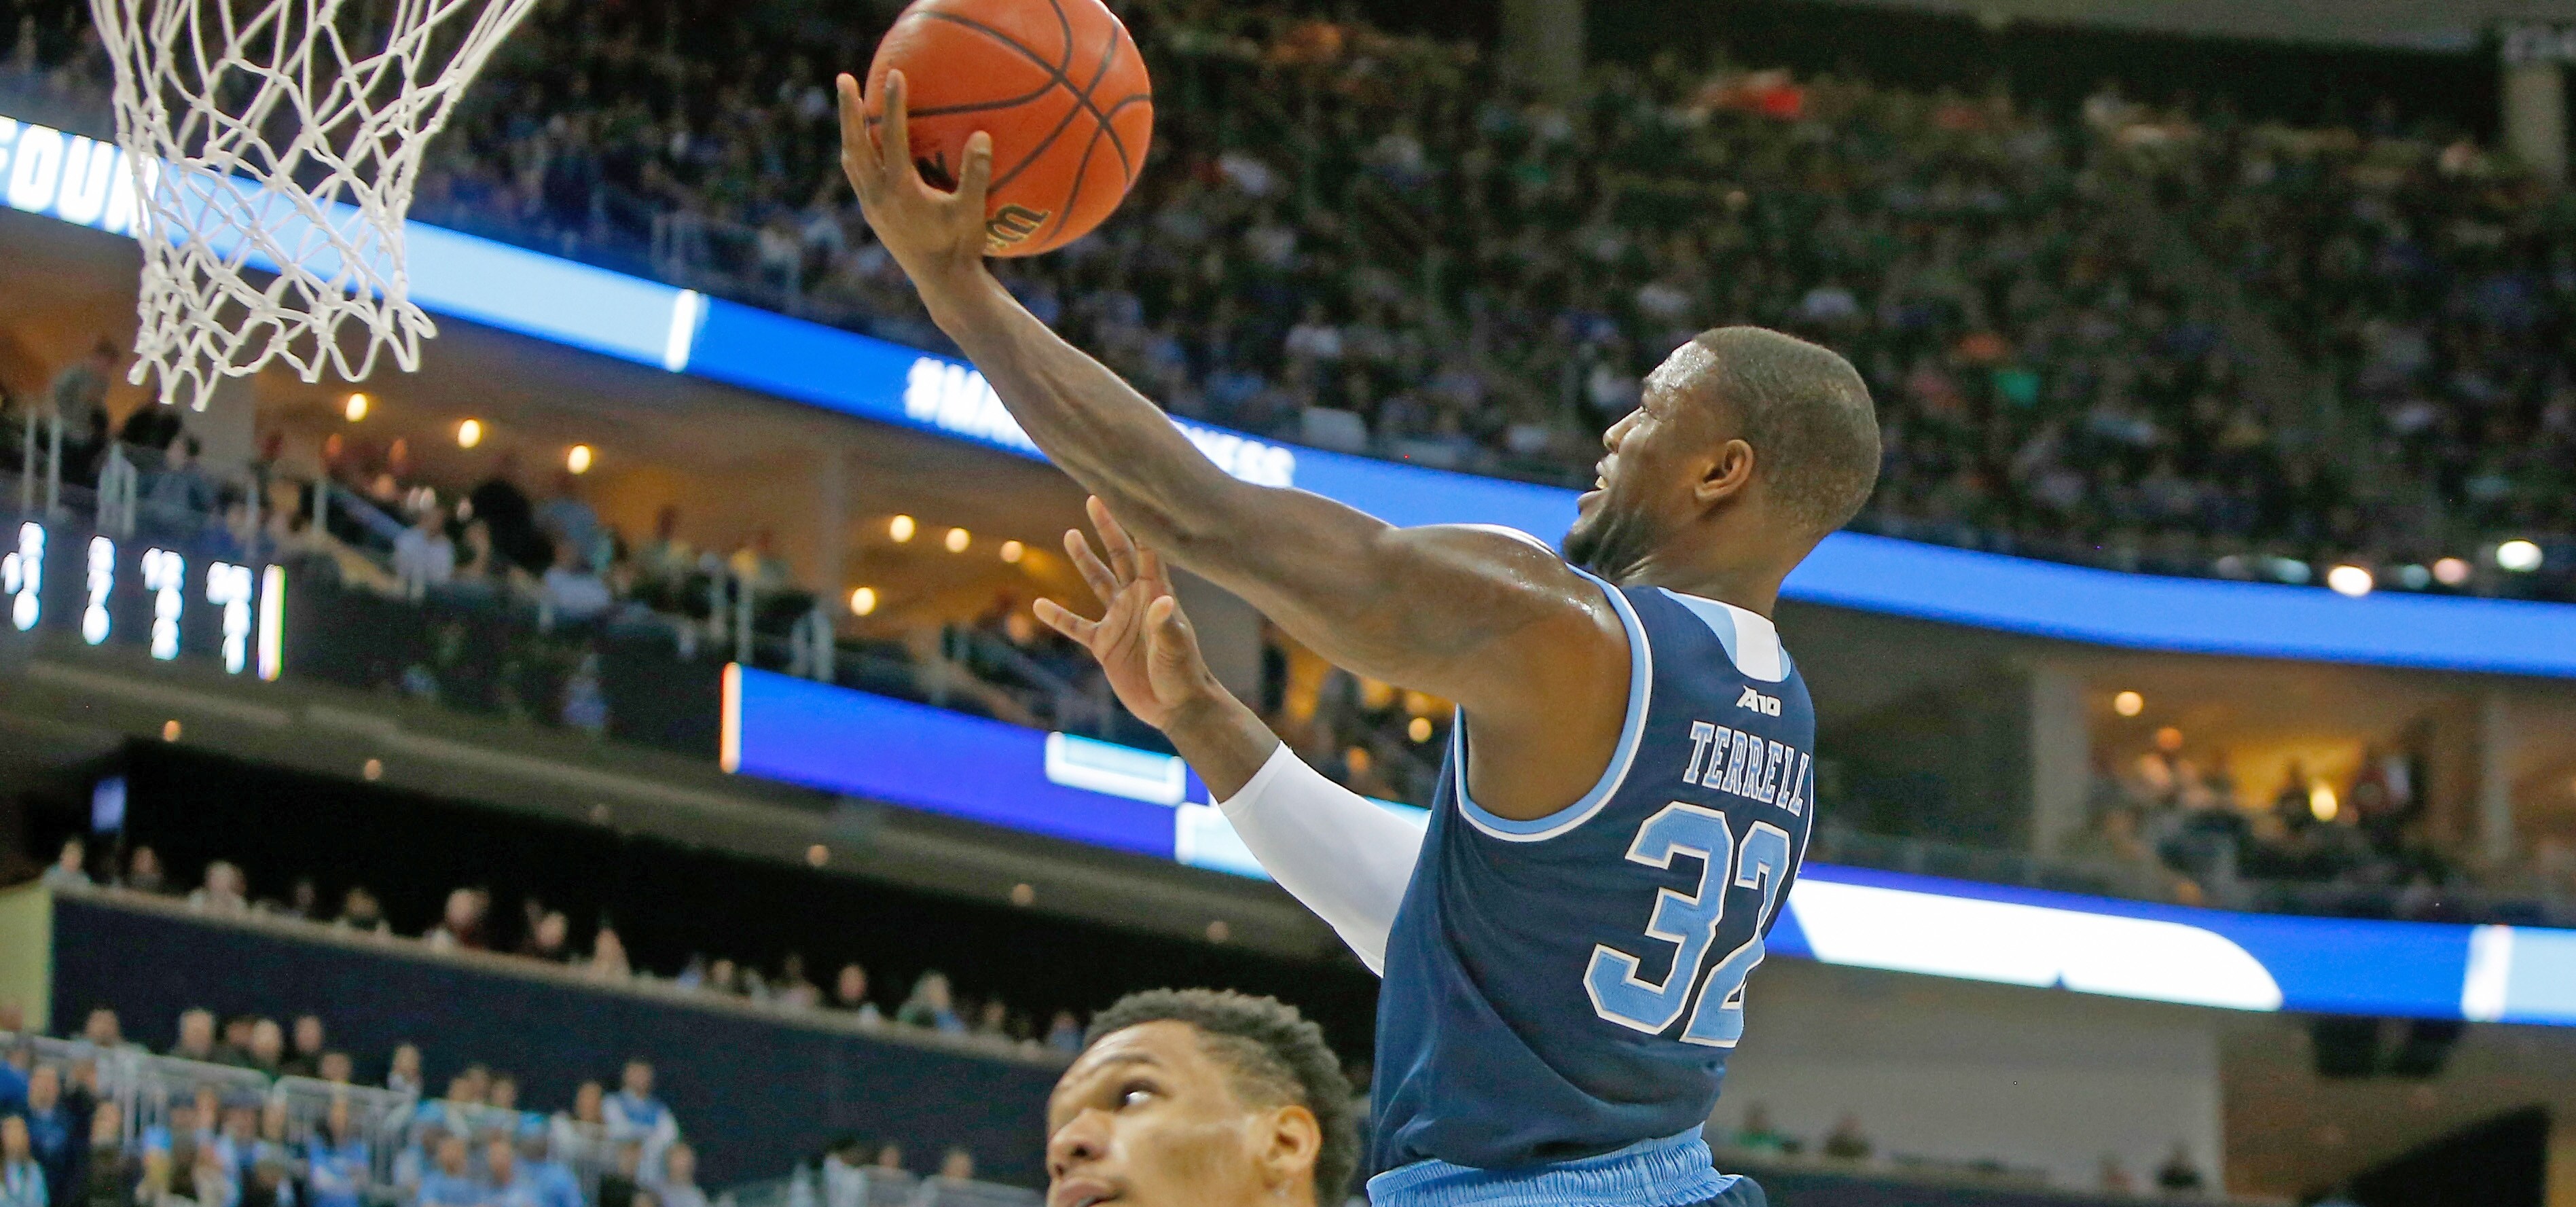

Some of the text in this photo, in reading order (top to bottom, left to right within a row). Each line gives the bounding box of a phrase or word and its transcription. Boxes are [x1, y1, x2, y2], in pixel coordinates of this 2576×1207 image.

[1736, 685, 1781, 717] A10
[1682, 720, 1811, 817] TERRELL
[1583, 800, 1791, 1048] 32
